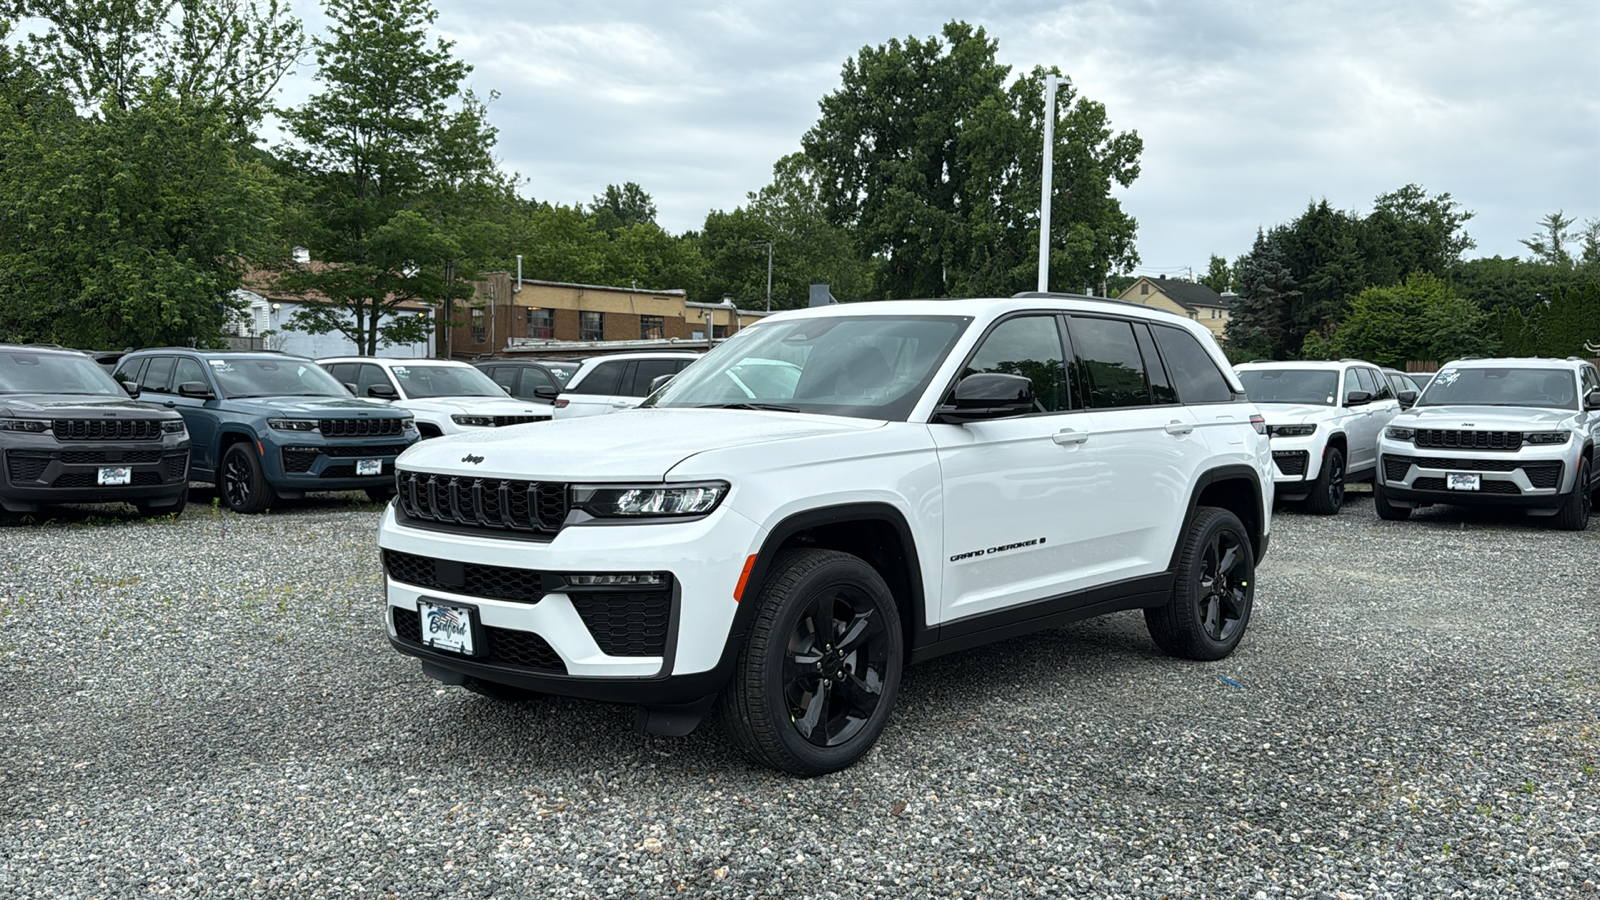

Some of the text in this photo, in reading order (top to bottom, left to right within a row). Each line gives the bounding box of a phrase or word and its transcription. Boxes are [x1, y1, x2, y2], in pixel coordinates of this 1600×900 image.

[461, 453, 485, 465] Jeep
[949, 539, 1038, 562] GRAND CHEROKEE
